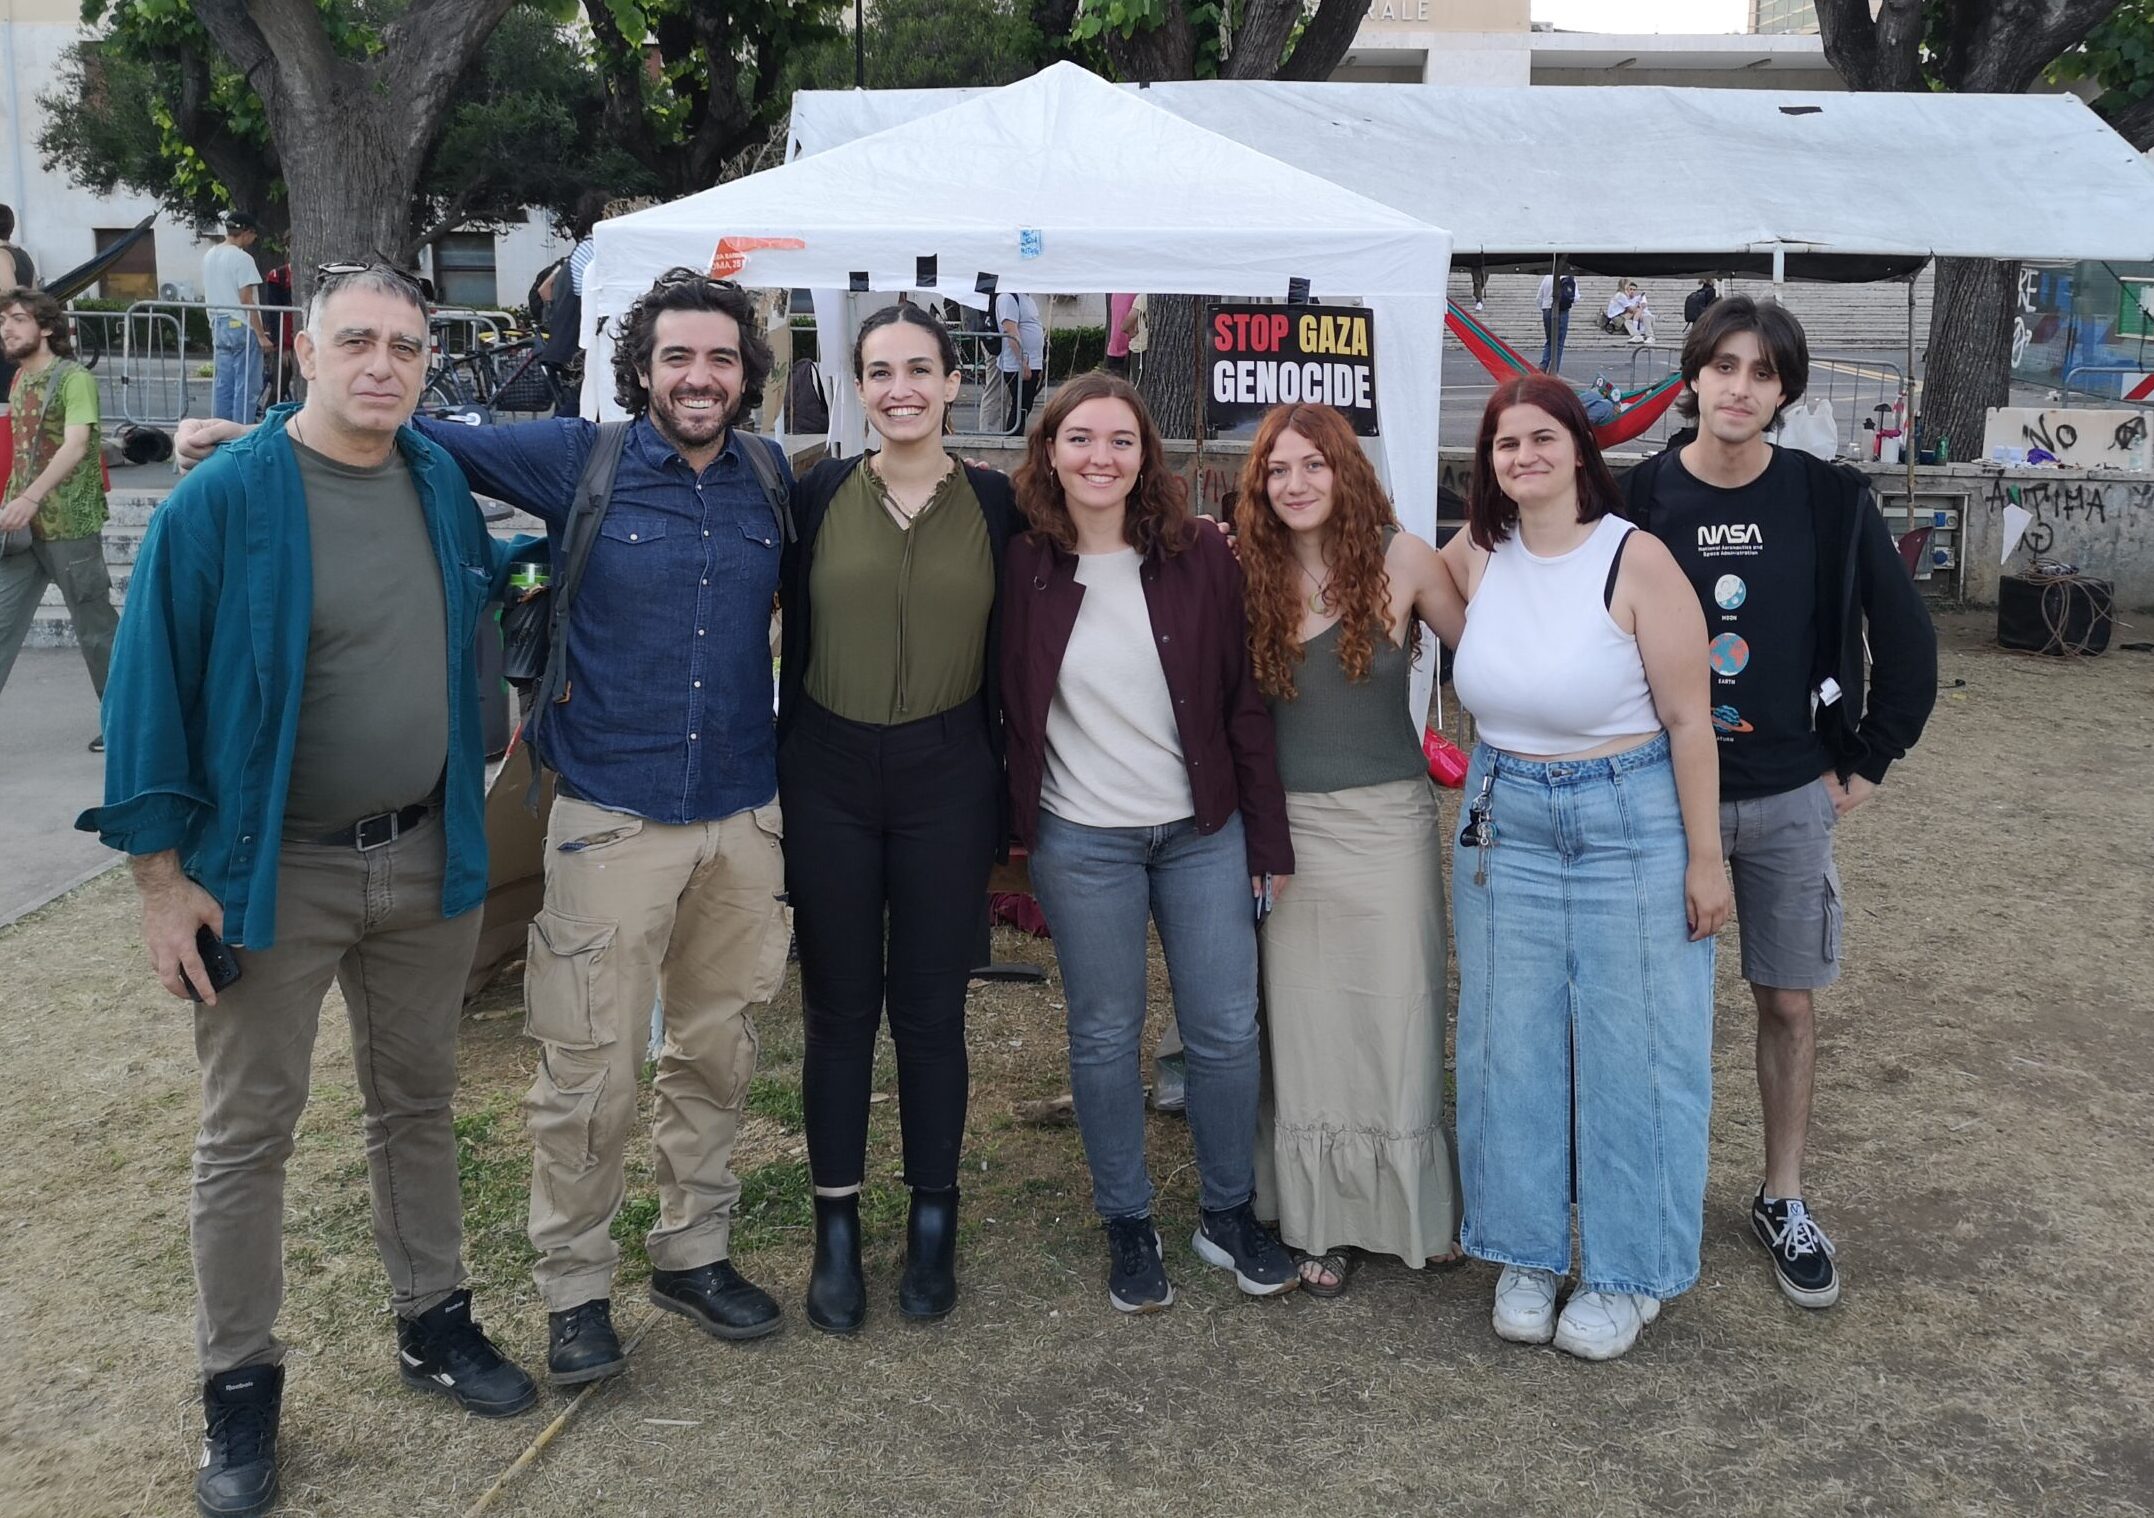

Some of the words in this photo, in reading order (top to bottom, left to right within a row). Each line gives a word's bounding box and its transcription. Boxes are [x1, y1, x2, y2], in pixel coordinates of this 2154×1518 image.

[1214, 313, 1289, 352] STOP
[1299, 314, 1369, 357] GAZA
[1213, 359, 1372, 409] GENOCIDE
[2022, 412, 2078, 453] NO
[1697, 523, 1763, 546] NASA
